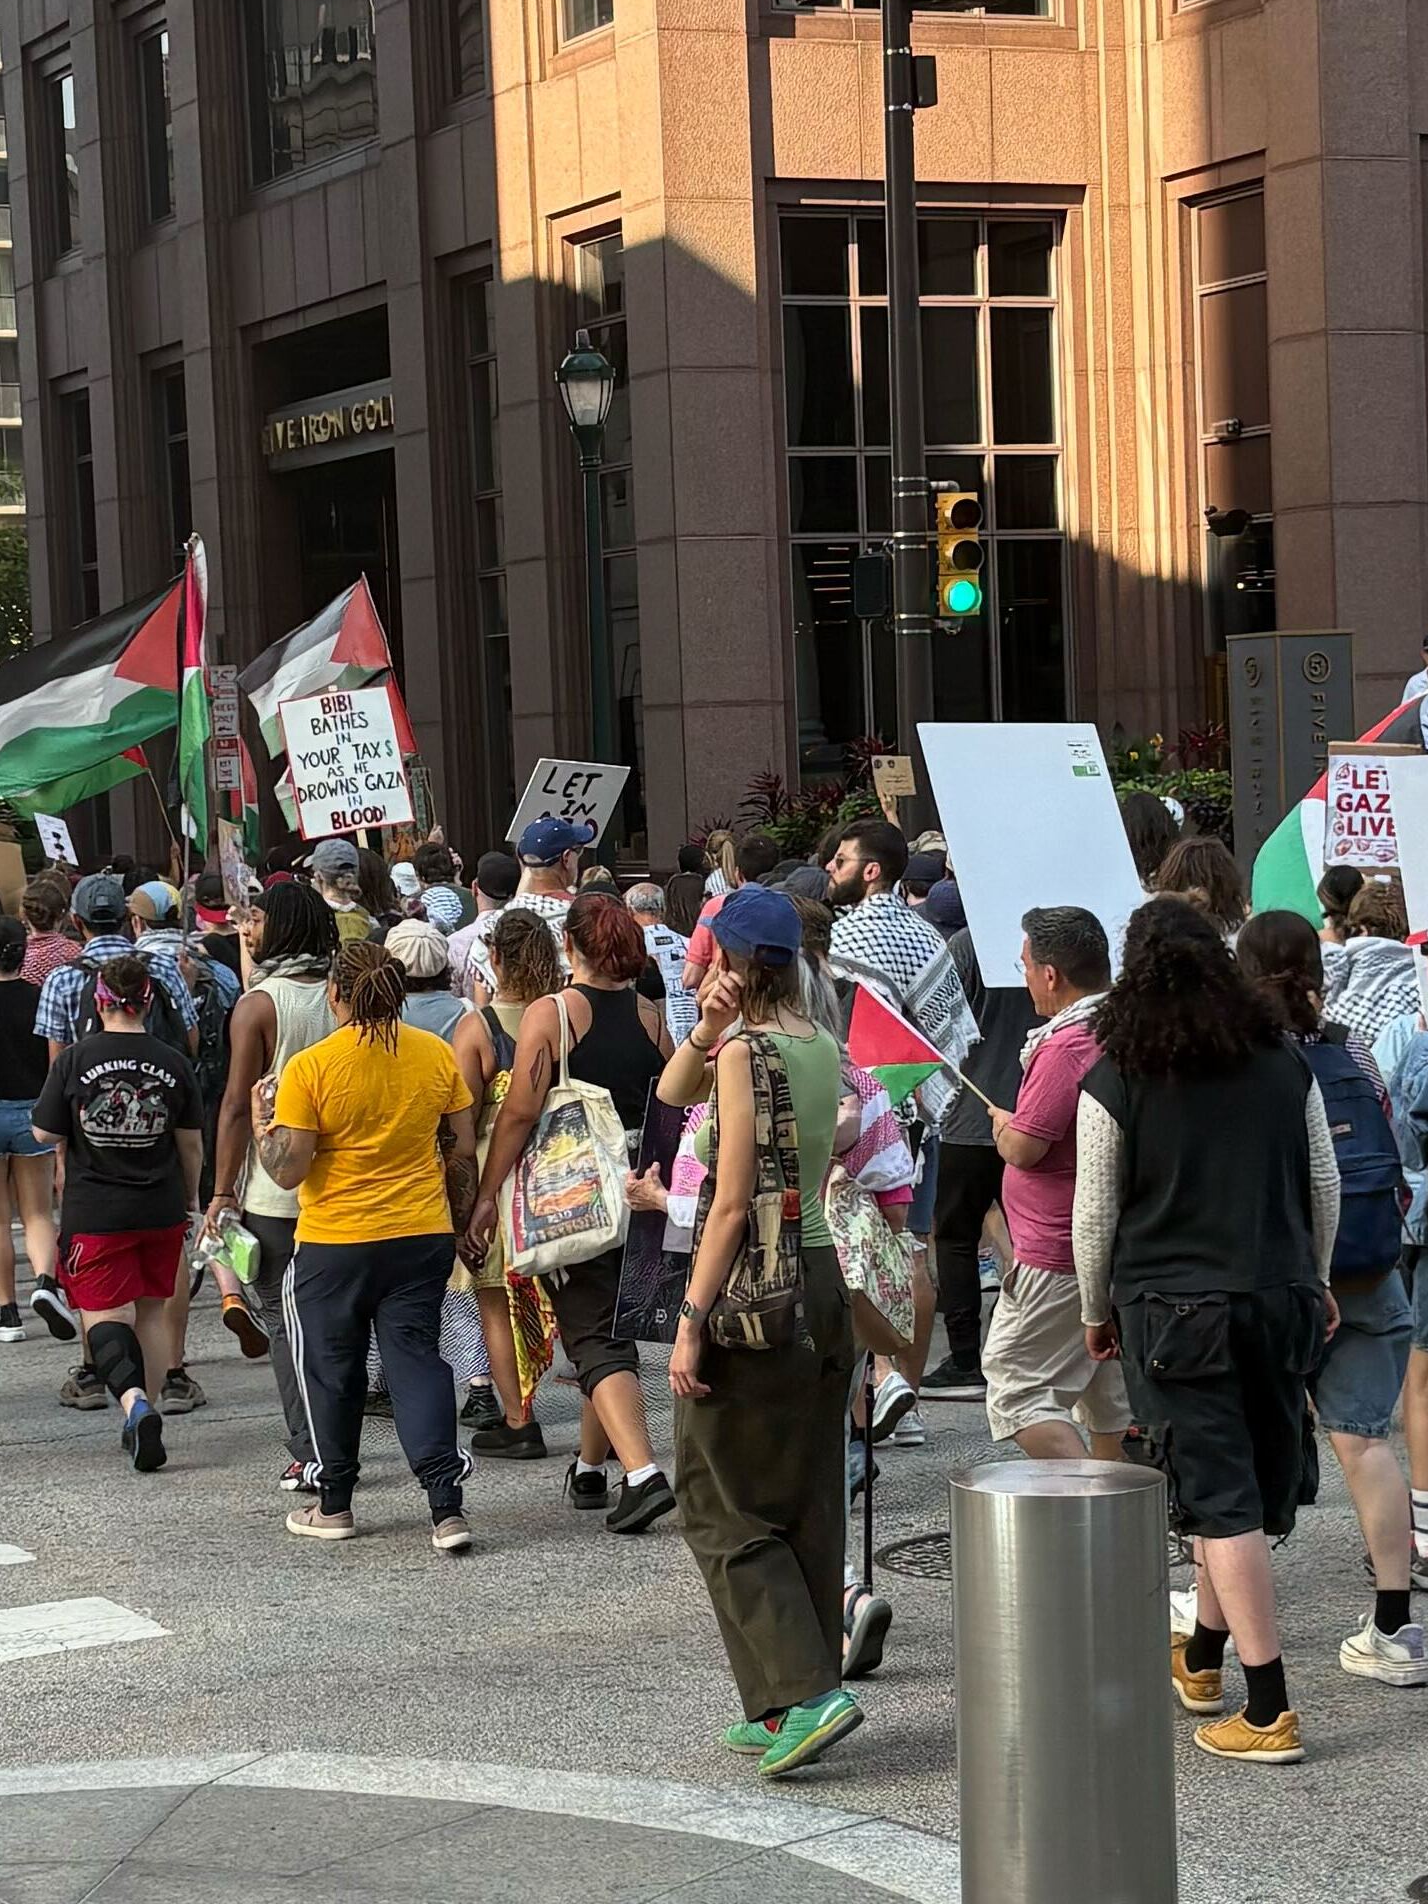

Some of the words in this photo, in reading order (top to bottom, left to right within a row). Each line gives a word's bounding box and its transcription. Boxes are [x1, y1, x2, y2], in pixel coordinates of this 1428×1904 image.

[301, 406, 345, 446] IRON
[320, 694, 354, 715] BIBI
[310, 711, 369, 736] BATHES
[1310, 692, 1329, 745] FIVE
[335, 732, 352, 746] IN
[296, 747, 341, 770] YOUR
[352, 741, 382, 761] TAX
[327, 765, 345, 779] AS
[353, 761, 370, 774] HE
[1351, 769, 1390, 790] LE
[296, 777, 360, 804] DROWNS
[364, 771, 406, 792] GAZA
[542, 766, 604, 798] LET
[347, 795, 364, 808] IN
[560, 799, 598, 817] IN
[1336, 792, 1392, 814] GAZ
[330, 805, 388, 831] BLOOD!
[1347, 816, 1397, 837] LIVE
[79, 1059, 138, 1085] LURKING
[140, 1062, 177, 1089] CLASS
